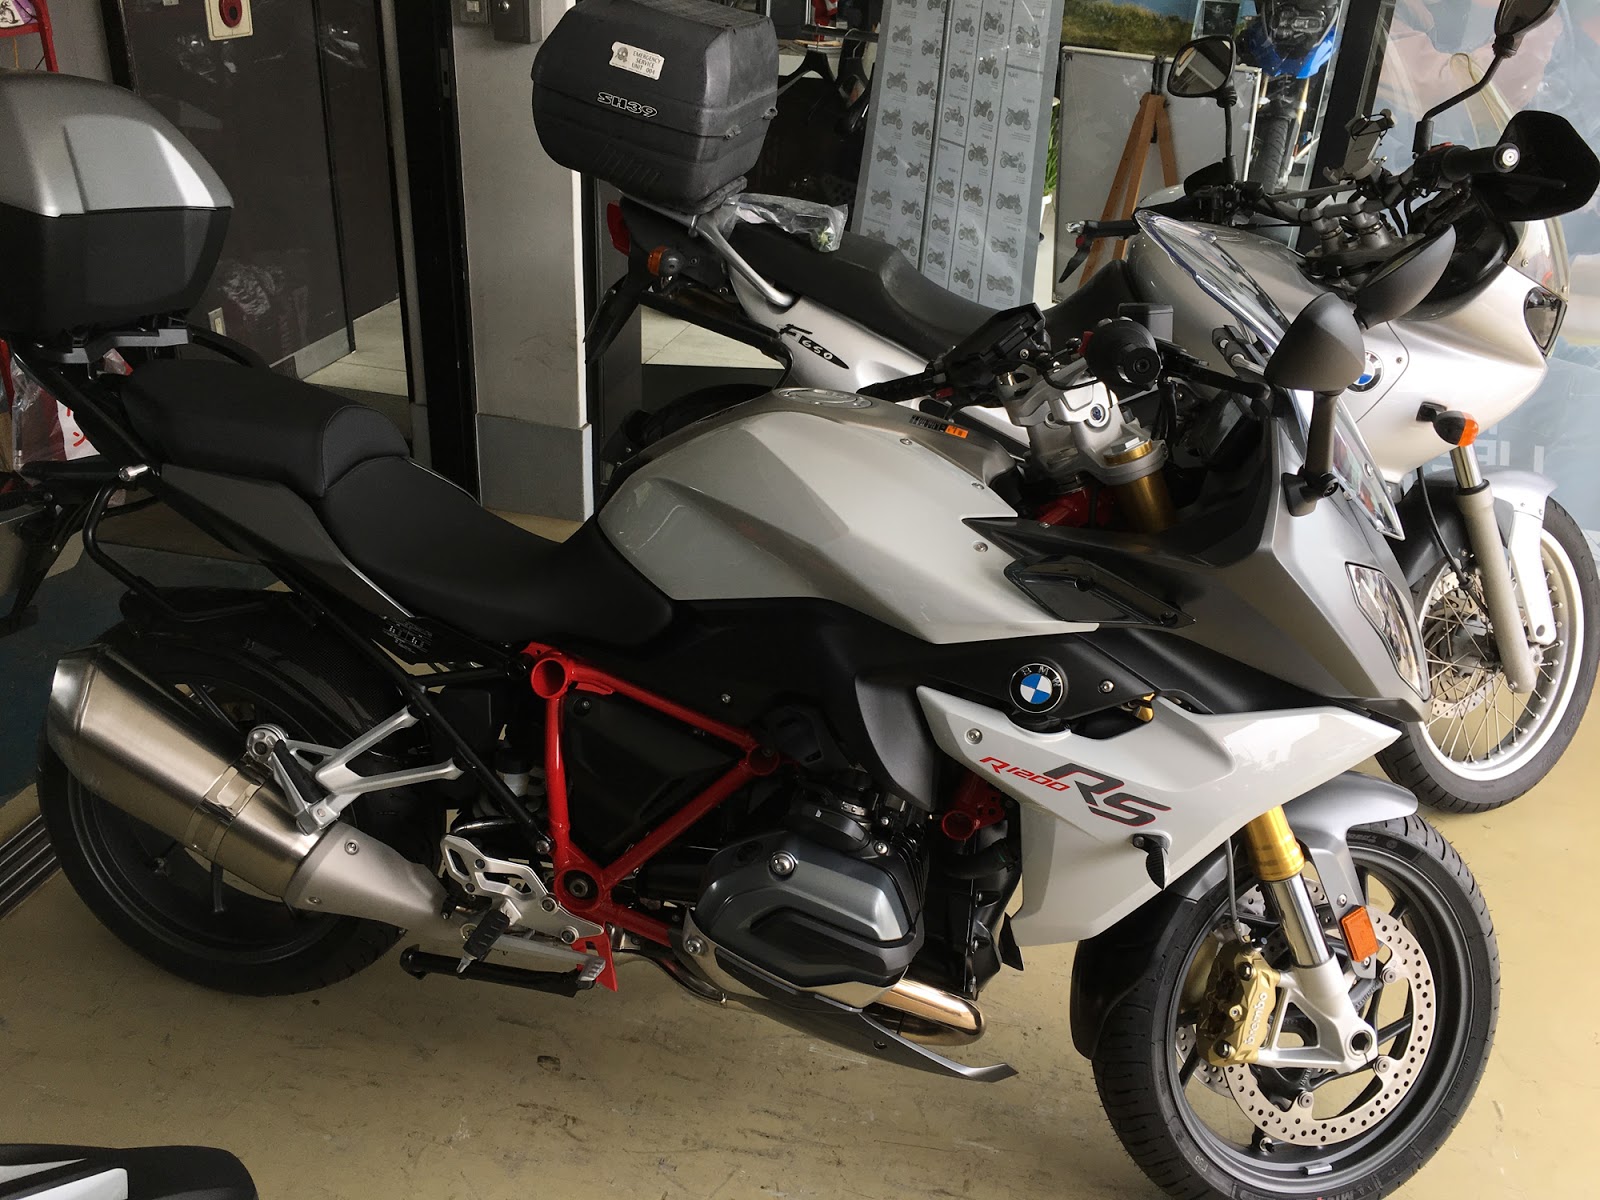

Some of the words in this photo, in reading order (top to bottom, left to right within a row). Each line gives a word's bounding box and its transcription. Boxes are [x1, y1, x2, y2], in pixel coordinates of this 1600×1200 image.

[632, 51, 661, 64] EMERGENCY
[636, 58, 655, 68] SERVICE
[597, 91, 658, 117] SH39
[1020, 665, 1061, 688] BMW
[979, 756, 1071, 792] R1200
[1043, 762, 1172, 827] RS
[1244, 992, 1268, 1045] brembo
